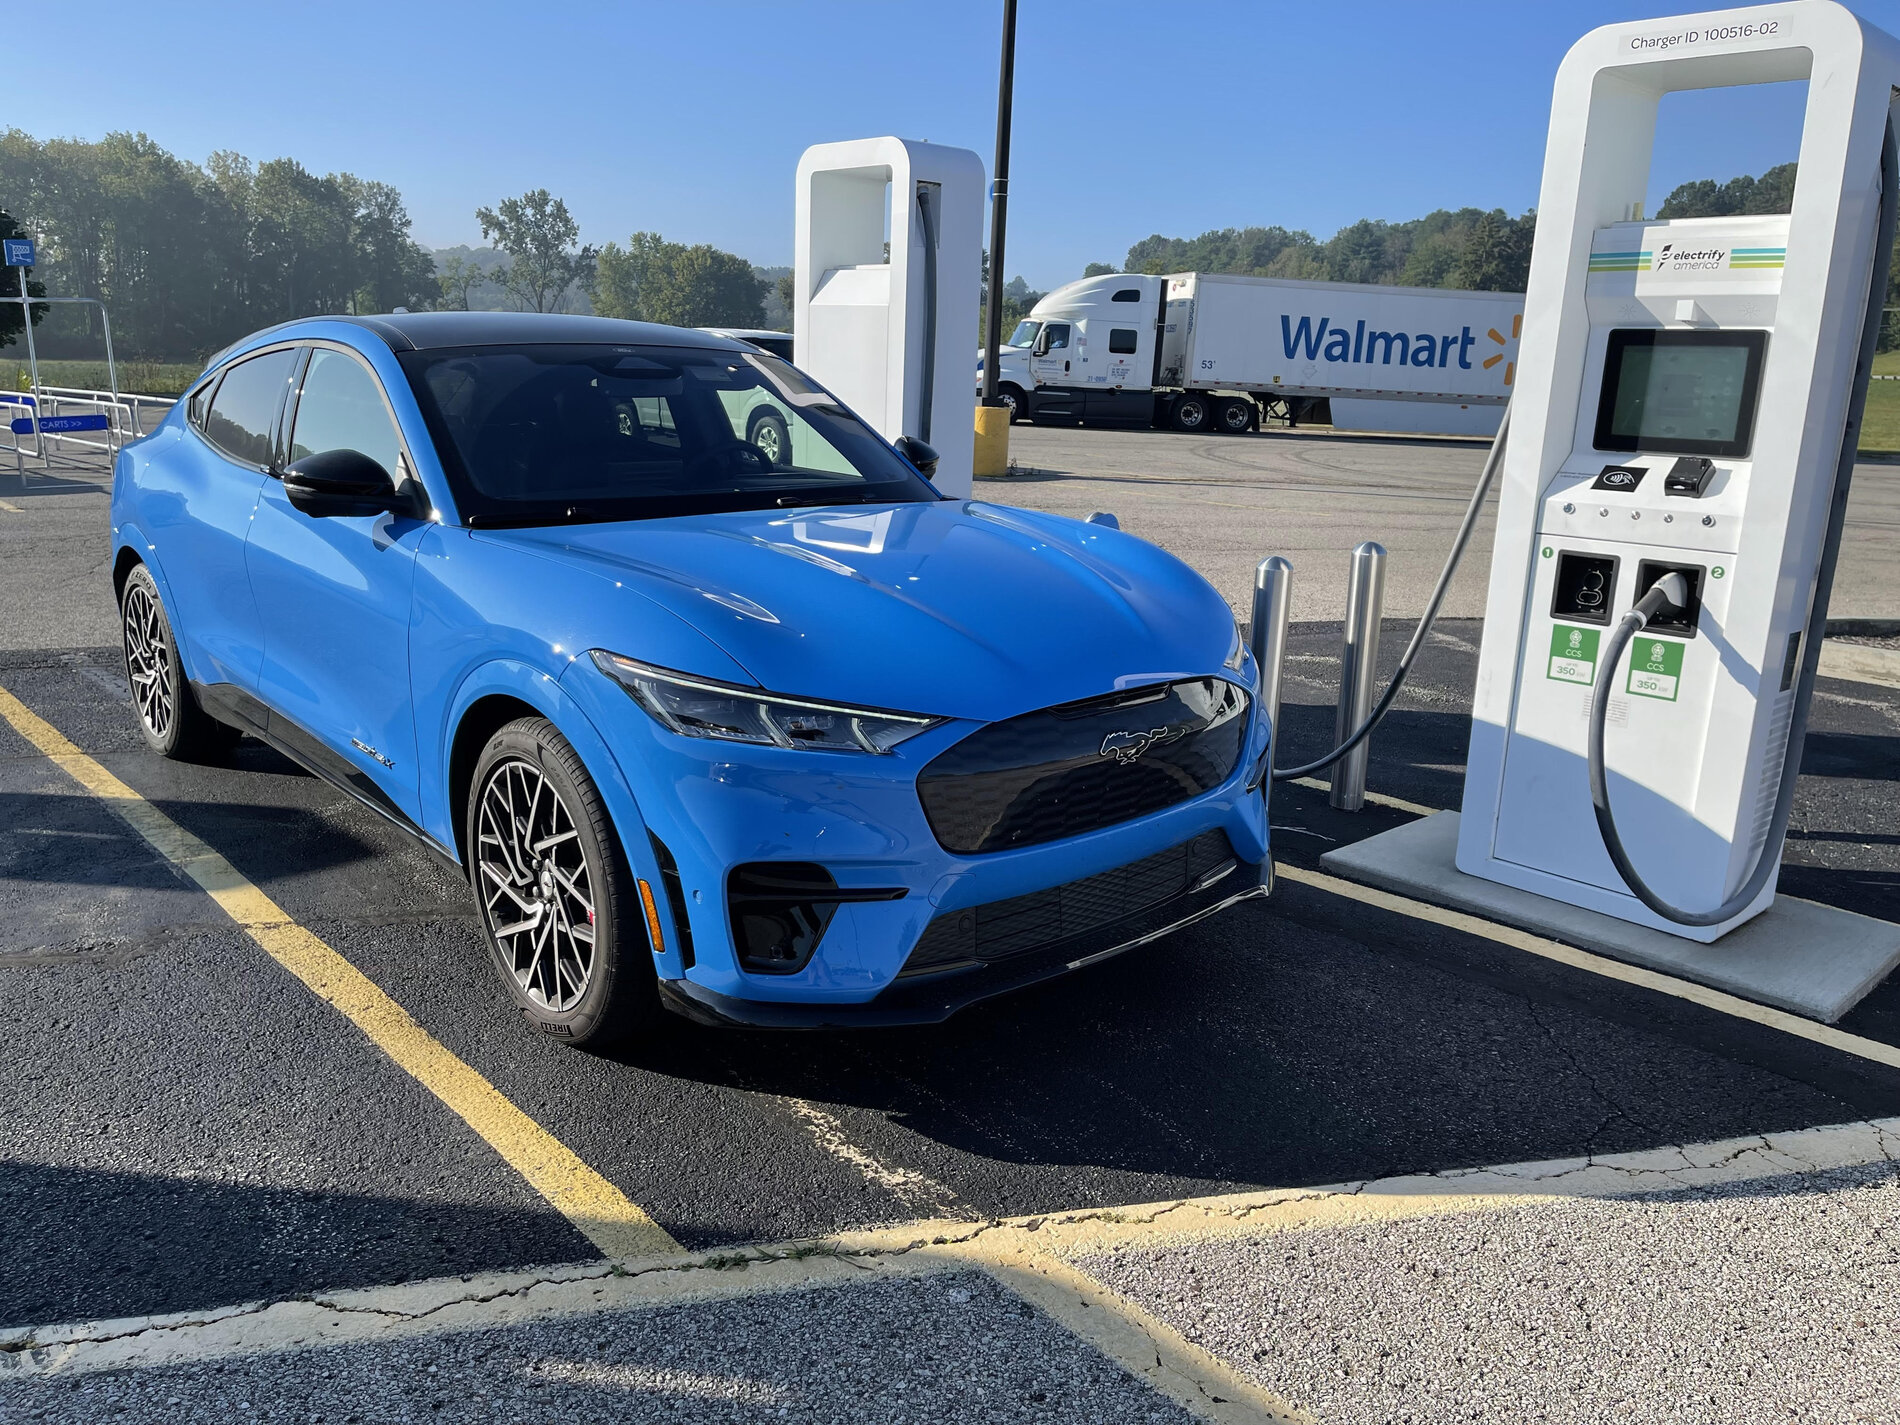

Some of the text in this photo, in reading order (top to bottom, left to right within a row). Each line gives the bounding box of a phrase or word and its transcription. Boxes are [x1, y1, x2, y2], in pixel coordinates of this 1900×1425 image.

[1630, 21, 1779, 50] Charger ID 100516-02
[1673, 249, 1726, 262] electrify
[1673, 261, 1720, 270] america
[1280, 314, 1476, 370] Walmart
[40, 420, 69, 429] CARTS
[135, 571, 152, 589] ZERO
[1565, 649, 1582, 658] CCS
[1556, 665, 1576, 676] 350
[1646, 662, 1665, 672] CCS
[1636, 680, 1657, 690] 350
[540, 1021, 575, 1037] PIRELLI
